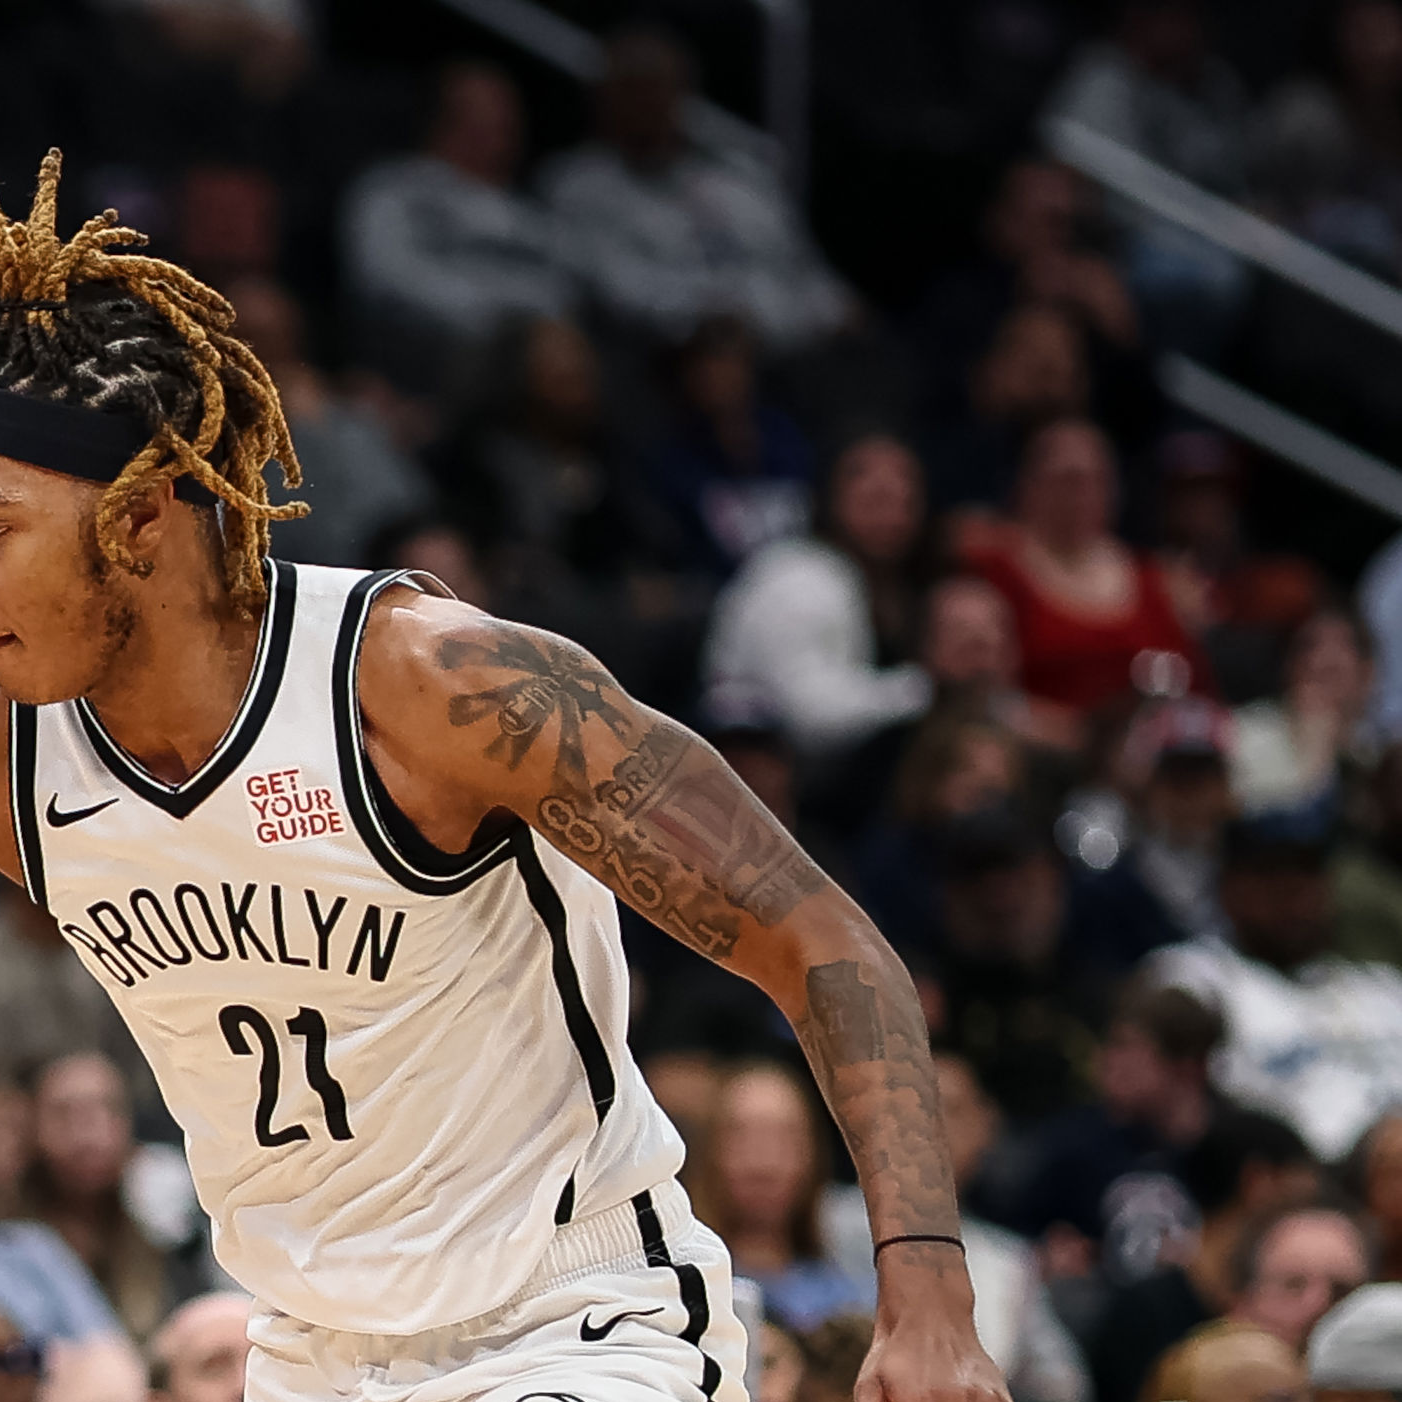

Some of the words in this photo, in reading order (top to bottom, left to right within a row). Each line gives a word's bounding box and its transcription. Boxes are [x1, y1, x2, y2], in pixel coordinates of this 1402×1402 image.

[247, 769, 299, 797] GET
[250, 789, 335, 820] YOUR
[257, 812, 344, 843] GUIDE
[62, 883, 406, 987] BROOKLYN
[218, 1004, 355, 1147] 21
